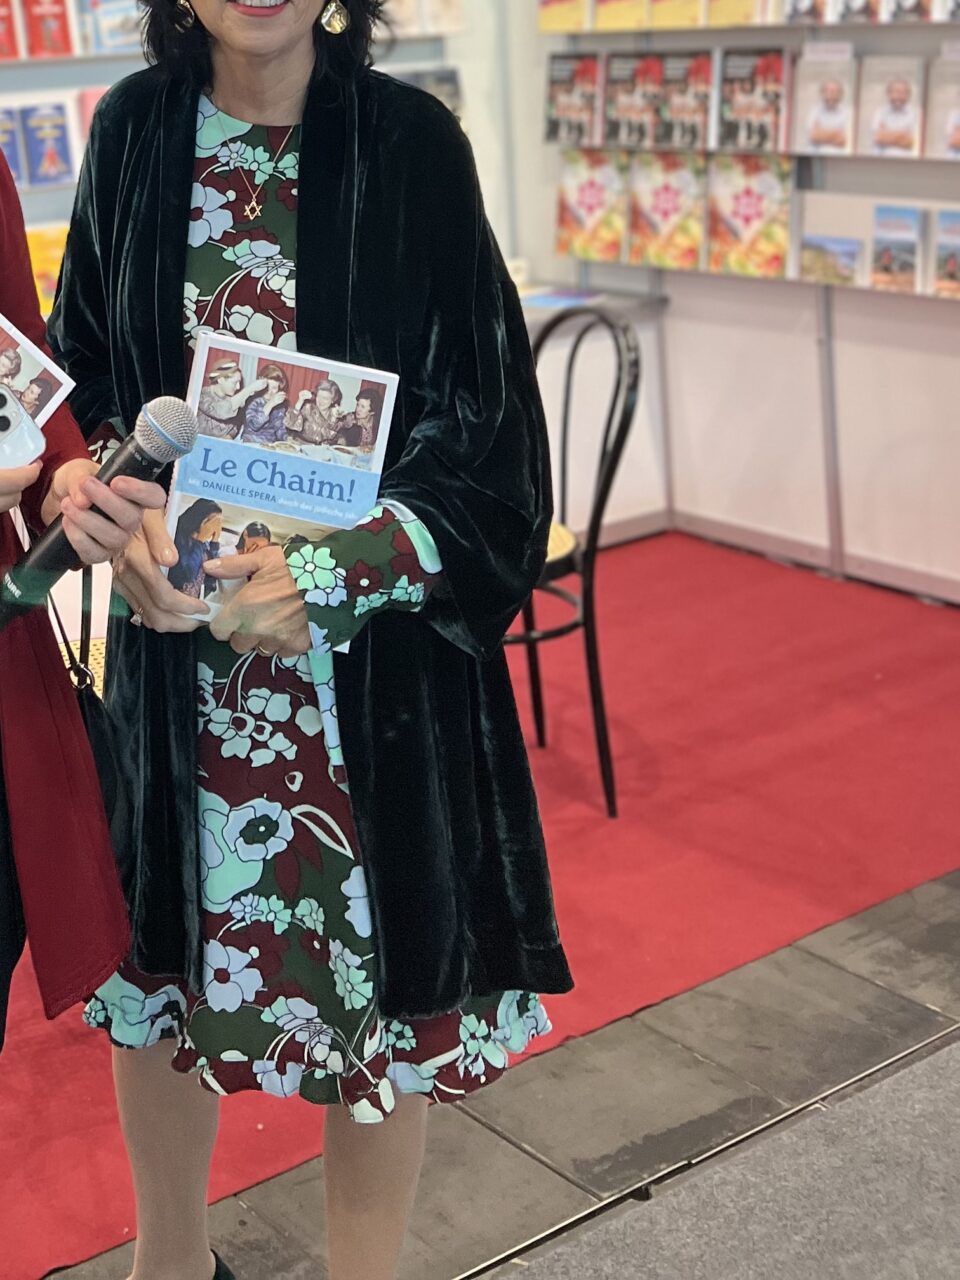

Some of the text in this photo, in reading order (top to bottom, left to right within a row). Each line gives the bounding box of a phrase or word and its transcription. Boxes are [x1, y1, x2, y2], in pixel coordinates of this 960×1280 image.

[200, 447, 356, 503] Le Chaim!
[202, 479, 246, 497] DANIELLE
[248, 489, 277, 504] SPERA
